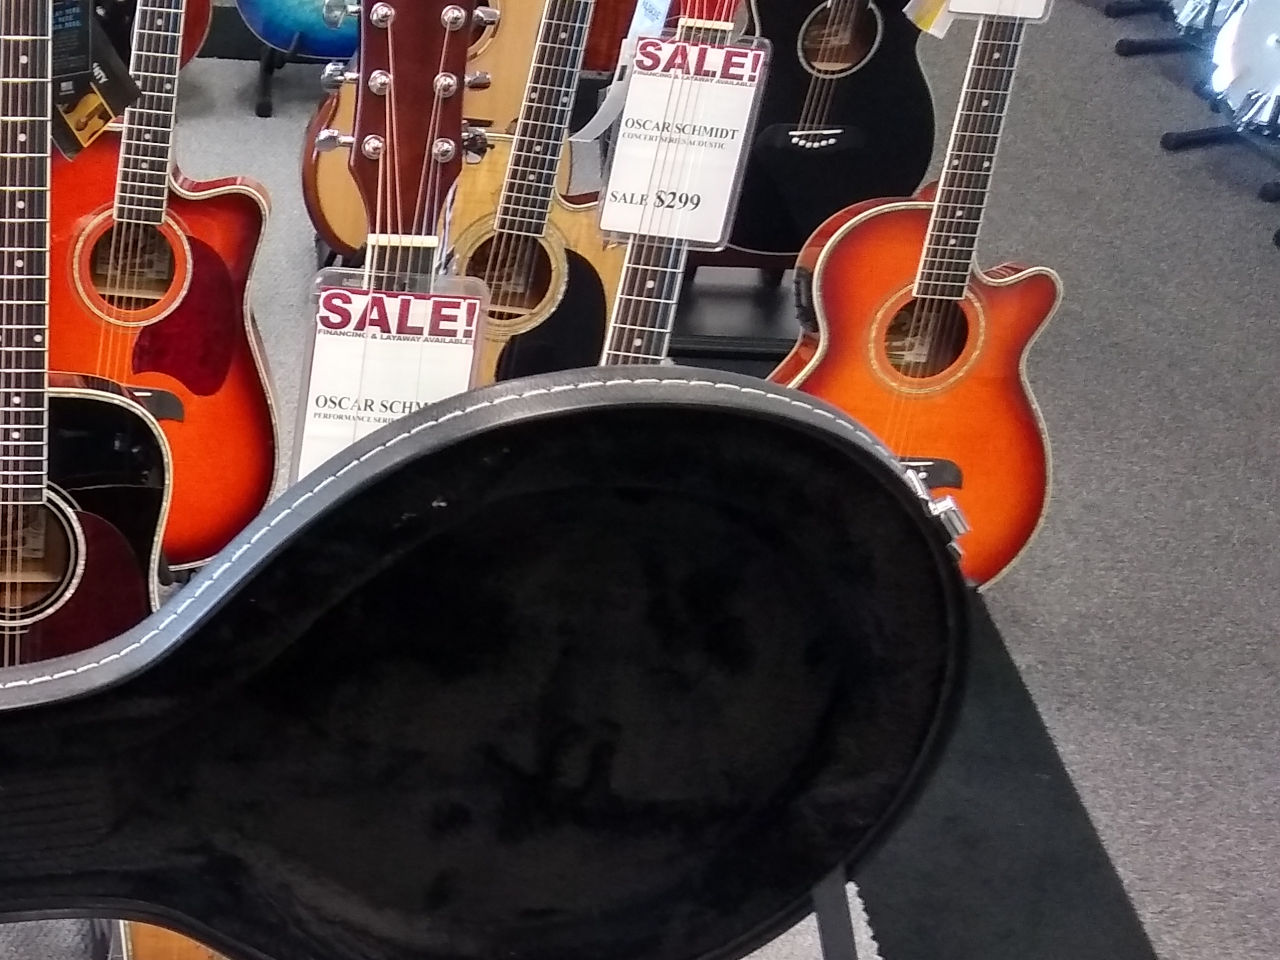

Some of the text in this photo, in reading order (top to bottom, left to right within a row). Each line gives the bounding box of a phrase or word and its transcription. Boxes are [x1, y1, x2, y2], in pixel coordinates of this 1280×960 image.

[635, 41, 761, 82] SALE!
[633, 70, 672, 79] FINANCING
[624, 117, 739, 140] OSCAR SCHMIDT
[622, 132, 658, 142] CONCERT
[687, 139, 726, 149] ACOUSTIC
[609, 189, 701, 211] SALE $299
[319, 292, 477, 338] SALE!
[318, 328, 367, 339] FINANCING
[380, 334, 421, 343] LAYAWAY
[315, 394, 429, 414] OSCAR SCHM
[313, 412, 372, 423] PERFORMANCE
